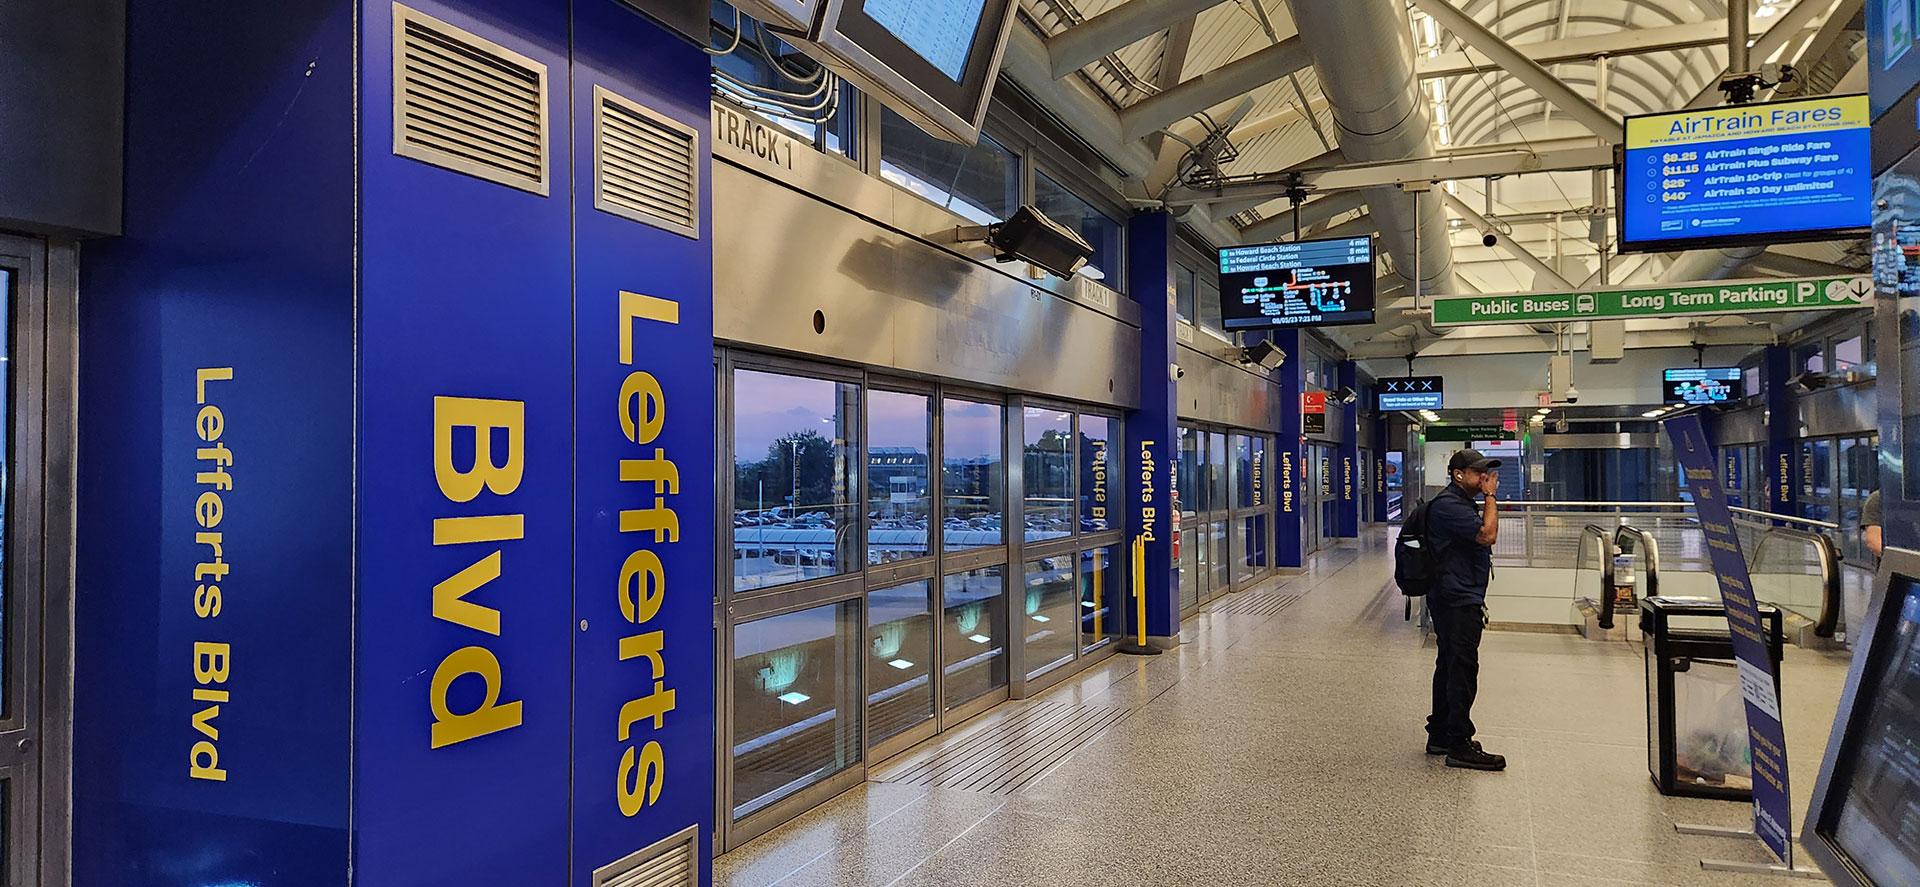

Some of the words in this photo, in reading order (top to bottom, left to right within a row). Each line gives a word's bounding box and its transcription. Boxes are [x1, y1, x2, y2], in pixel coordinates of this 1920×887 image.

[1669, 111, 1762, 135] AirTrain
[1771, 107, 1842, 125] Fares
[713, 104, 780, 165] TRACK
[785, 139, 792, 170] 1
[1662, 151, 1698, 164] $8.25
[1704, 148, 1746, 160] AirTrain
[1747, 145, 1780, 156] Single
[1781, 142, 1805, 152] Ride
[1806, 141, 1832, 150] Fare
[1662, 164, 1699, 176] $11.15
[1704, 161, 1746, 172] AirTrain
[1747, 159, 1770, 168] Plus
[1771, 156, 1813, 165] Subway
[1814, 154, 1839, 162] Fare
[1704, 174, 1745, 186] AirTrain
[1746, 171, 1782, 181] 10-trip
[1813, 169, 1836, 178] groups
[1704, 187, 1744, 198] AirTrain
[1746, 186, 1760, 195] 30
[1761, 185, 1782, 194] Day
[1783, 180, 1834, 192] unlimited
[1235, 247, 1259, 256] Howard
[1260, 246, 1278, 254] Beach
[1279, 244, 1301, 252] Station
[1355, 238, 1368, 246] min
[1237, 263, 1260, 271] Howard
[1260, 262, 1279, 270] Beach
[1280, 260, 1302, 268] Station
[1259, 254, 1276, 262] Circle
[1084, 279, 1104, 304] TRACK
[1621, 294, 1665, 310] Long
[1669, 291, 1714, 305] Term
[1719, 287, 1788, 304] Parking
[1797, 282, 1816, 302] P
[1471, 300, 1518, 315] Public
[1523, 299, 1570, 312] Buses
[1141, 441, 1155, 503] Lefferts
[1282, 452, 1291, 489] Lefferts
[1780, 453, 1788, 484] Lefferts
[194, 366, 233, 619] Lefferts
[1283, 491, 1292, 512] Blvd
[1780, 485, 1789, 502] Blvd
[1142, 507, 1156, 541] Blvd
[617, 290, 679, 817] Lefferts
[430, 396, 525, 750] Blvd
[190, 641, 230, 782] Blvd
